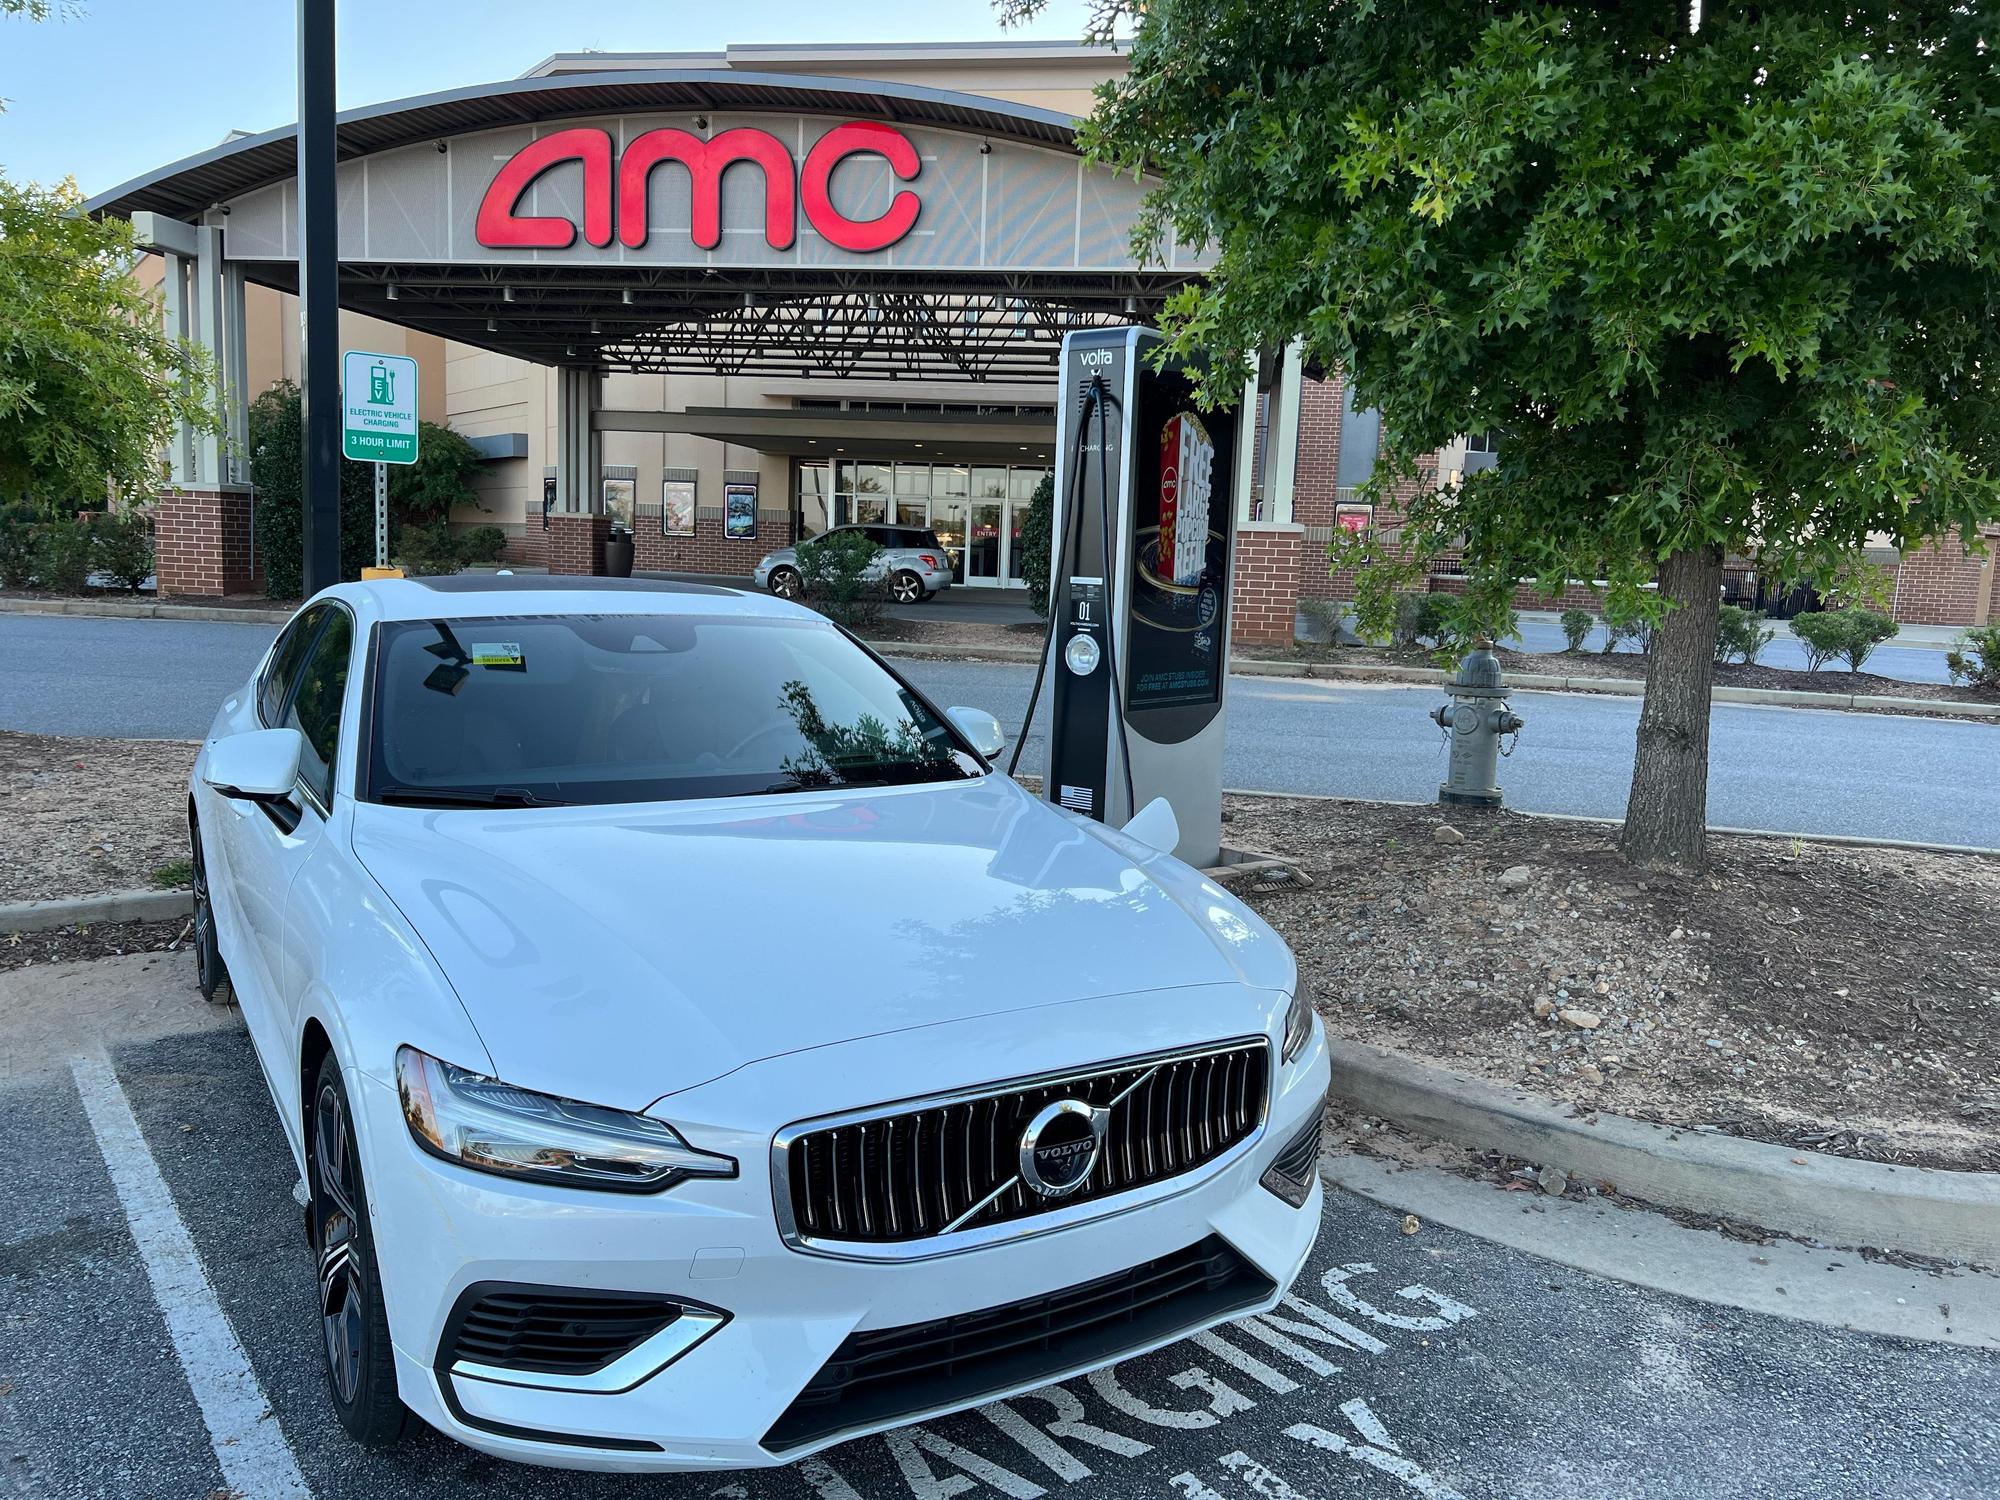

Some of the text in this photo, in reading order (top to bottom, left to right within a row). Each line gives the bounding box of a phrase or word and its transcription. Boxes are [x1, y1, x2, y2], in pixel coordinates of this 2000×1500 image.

[1080, 349, 1113, 366] volta
[349, 408, 412, 420] ELECTRIC VEHICLE
[363, 418, 399, 428] CHARGING
[351, 435, 411, 449] 3 HOUR LIMIT
[1080, 444, 1114, 453] CHARGNG
[1079, 601, 1090, 621] 01
[1038, 1140, 1093, 1160] VOLVO
